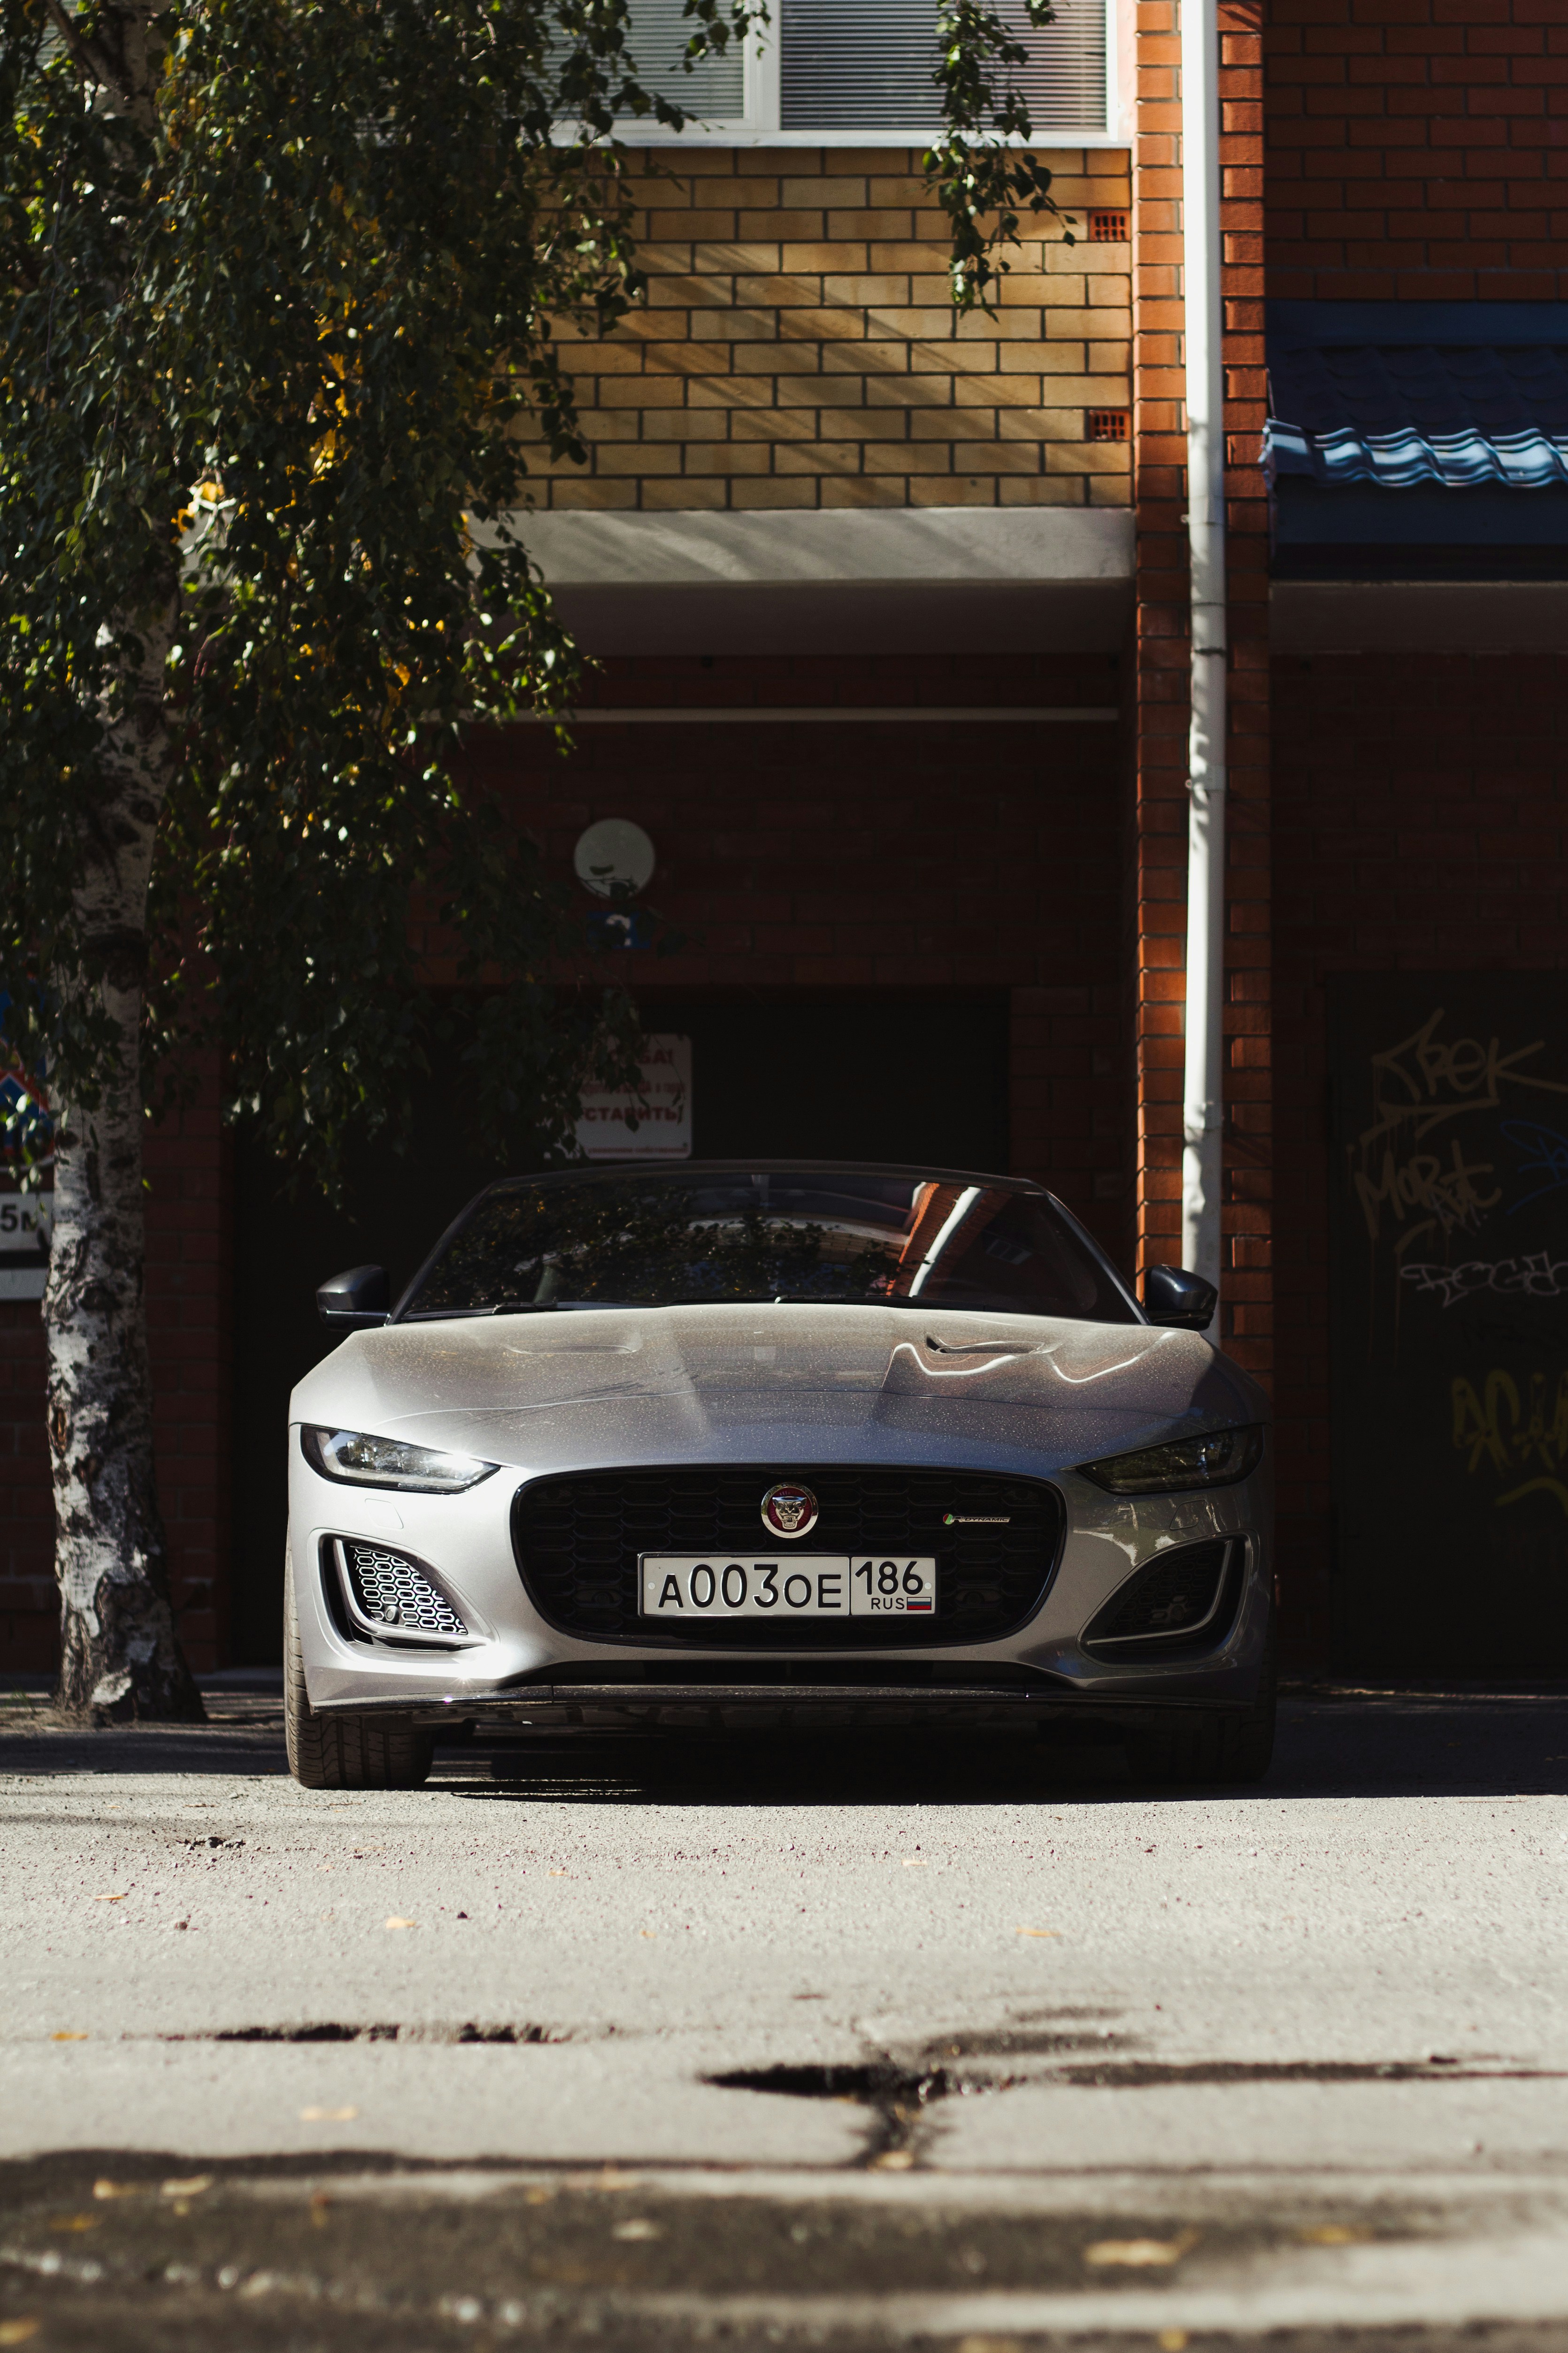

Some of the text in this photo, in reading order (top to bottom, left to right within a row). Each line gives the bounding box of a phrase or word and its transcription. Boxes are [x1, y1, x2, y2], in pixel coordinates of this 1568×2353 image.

[658, 1561, 923, 1608] А003ОЕ 186
[871, 1597, 905, 1610] RUS
